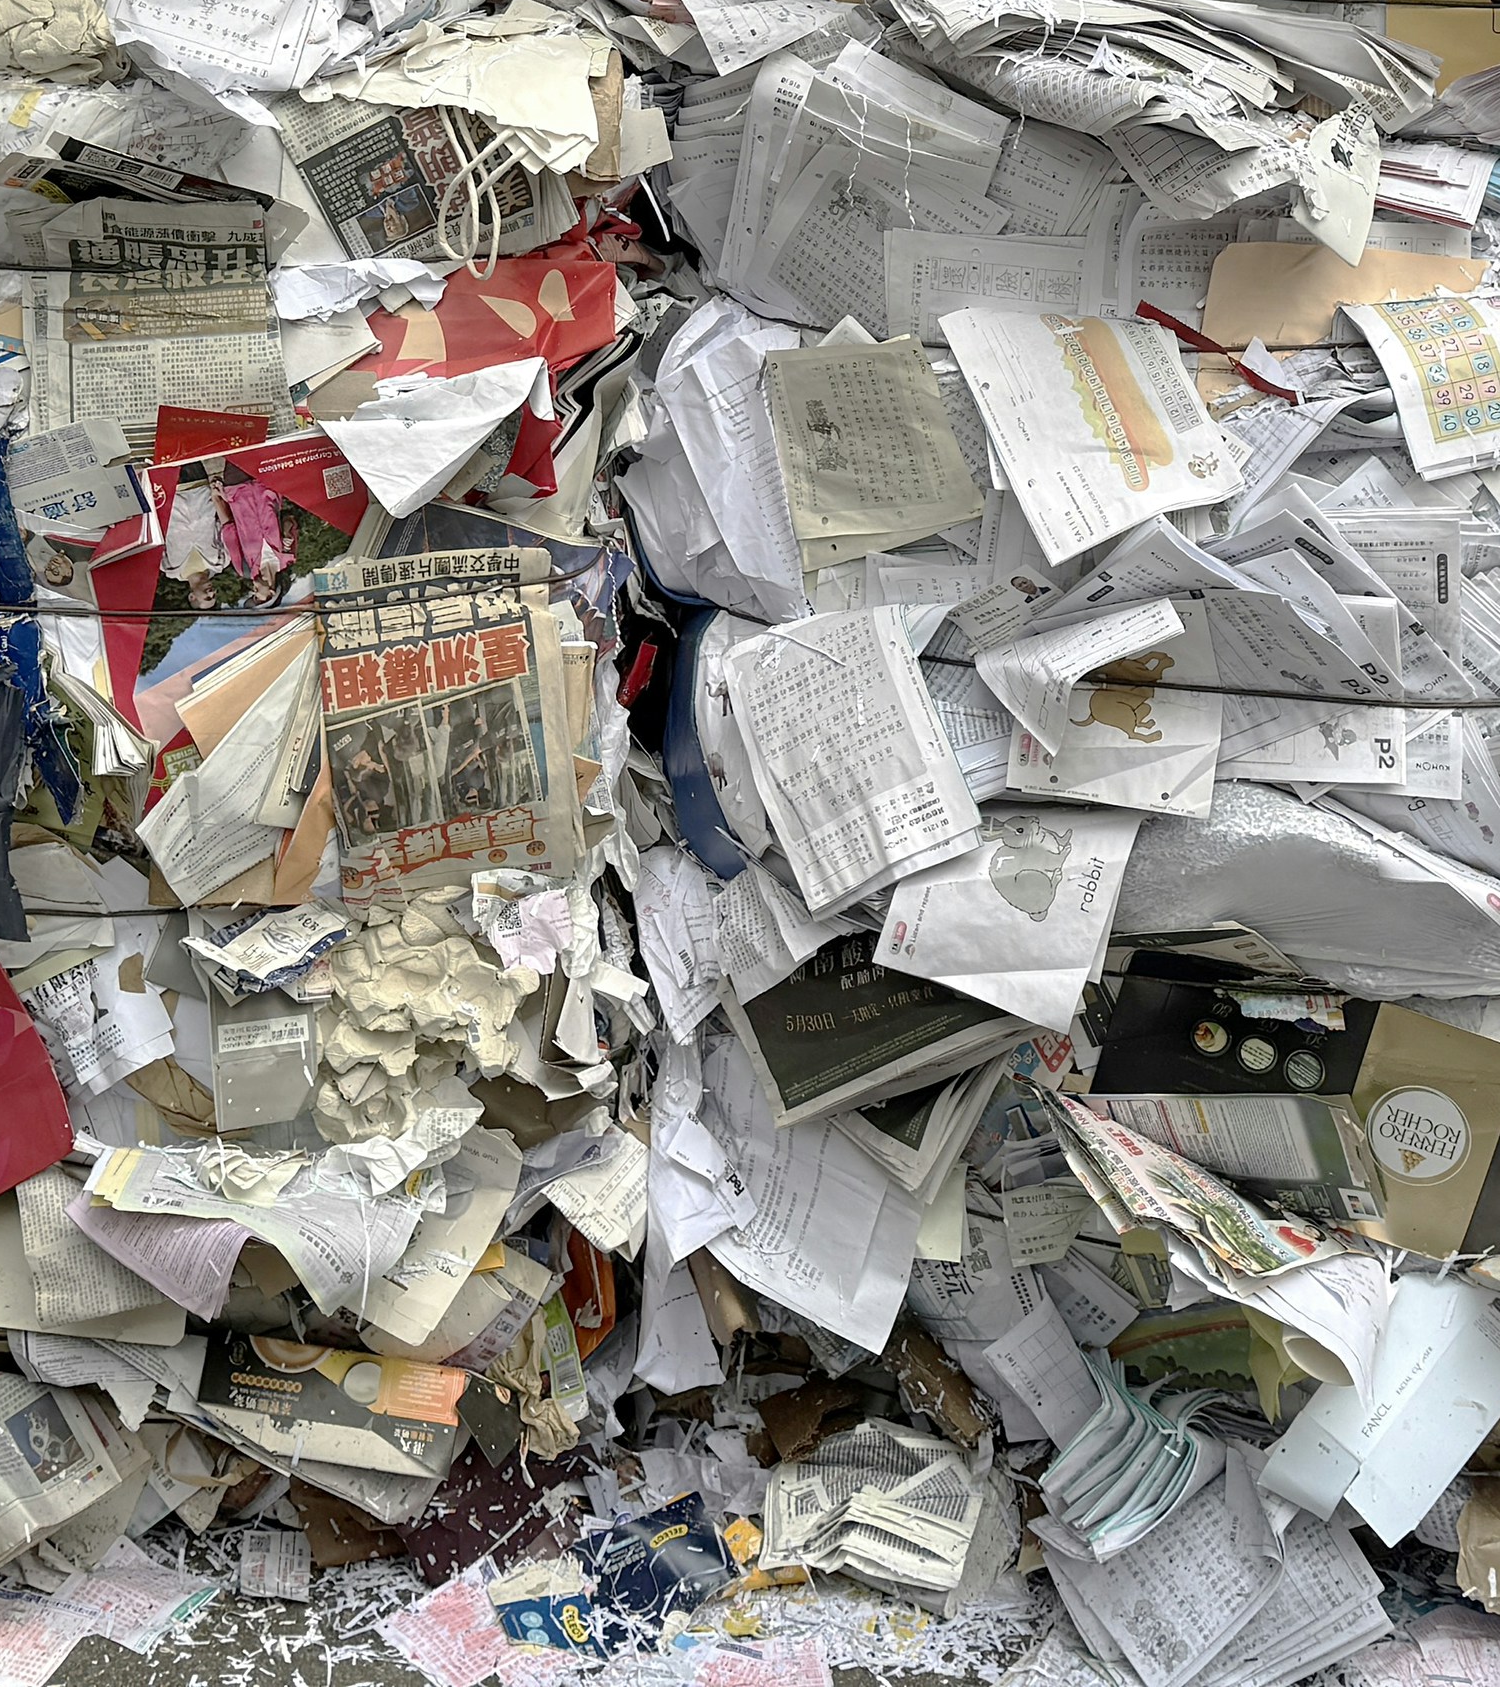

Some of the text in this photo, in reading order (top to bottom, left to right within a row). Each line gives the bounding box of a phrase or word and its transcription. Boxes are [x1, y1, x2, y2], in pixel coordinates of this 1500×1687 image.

[1340, 676, 1372, 695] P3
[1359, 661, 1390, 687] P2
[1418, 673, 1448, 695] KUMON
[1373, 737, 1396, 770] P2
[1414, 761, 1451, 772] KUMON
[1079, 856, 1107, 914] rabbit
[786, 1010, 836, 1032] 5月30日
[1386, 1104, 1461, 1145] ROCHER
[1379, 1121, 1459, 1161] FERRERO
[1361, 1402, 1392, 1438] FANCL
[652, 1525, 687, 1547] SELECT
